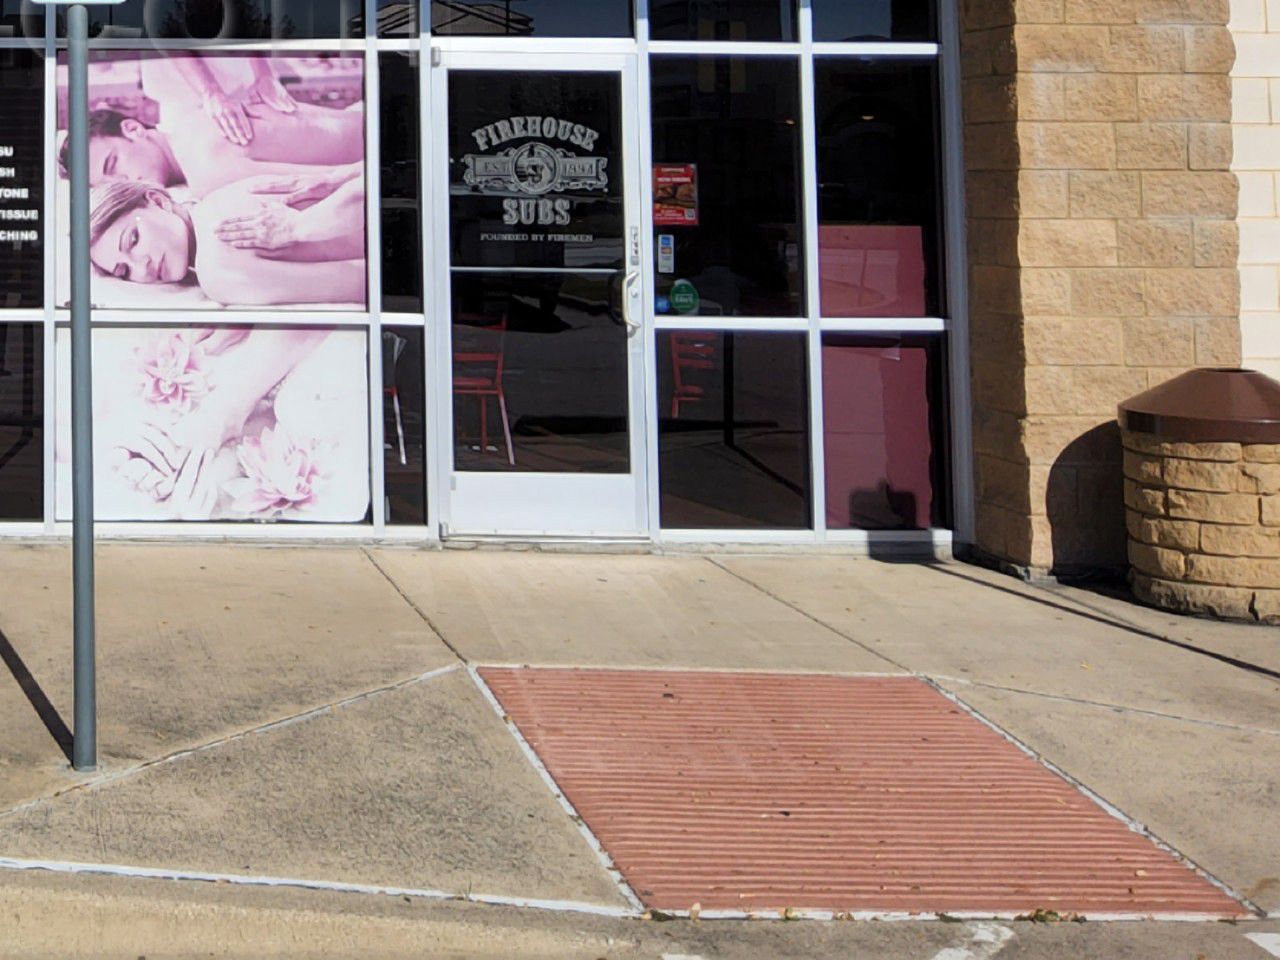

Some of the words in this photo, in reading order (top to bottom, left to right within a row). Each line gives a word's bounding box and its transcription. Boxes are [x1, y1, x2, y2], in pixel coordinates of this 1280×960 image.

[471, 116, 599, 152] FIREHOUSE
[502, 198, 571, 225] SUBS
[480, 233, 529, 242] FOUNDED
[531, 233, 545, 242] BY
[547, 234, 594, 243] FIREMEN
